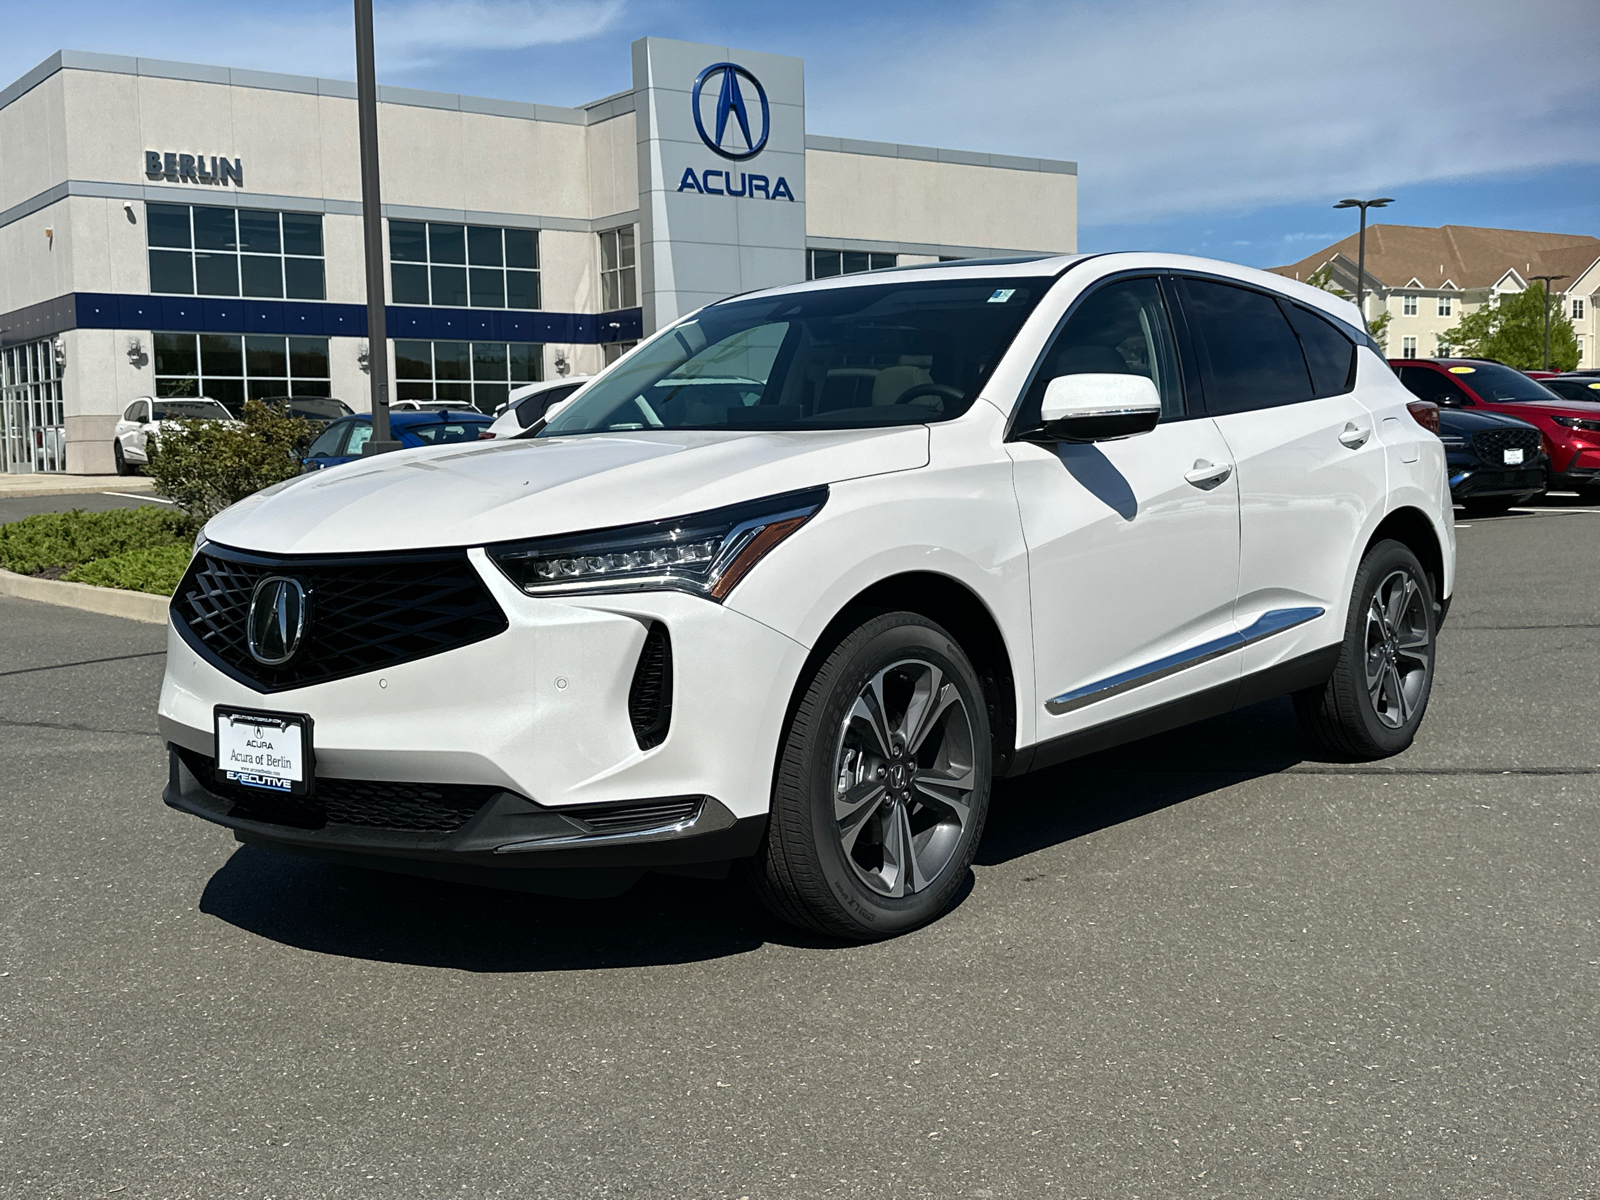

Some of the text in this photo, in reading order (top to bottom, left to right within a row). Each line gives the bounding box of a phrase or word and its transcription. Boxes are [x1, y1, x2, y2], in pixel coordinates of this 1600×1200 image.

[145, 150, 243, 186] BERLIN
[677, 167, 795, 202] ACURA
[246, 739, 274, 750] ACURA
[230, 749, 292, 769] Acura of Berlin
[226, 771, 292, 789] EXECUTIVE
